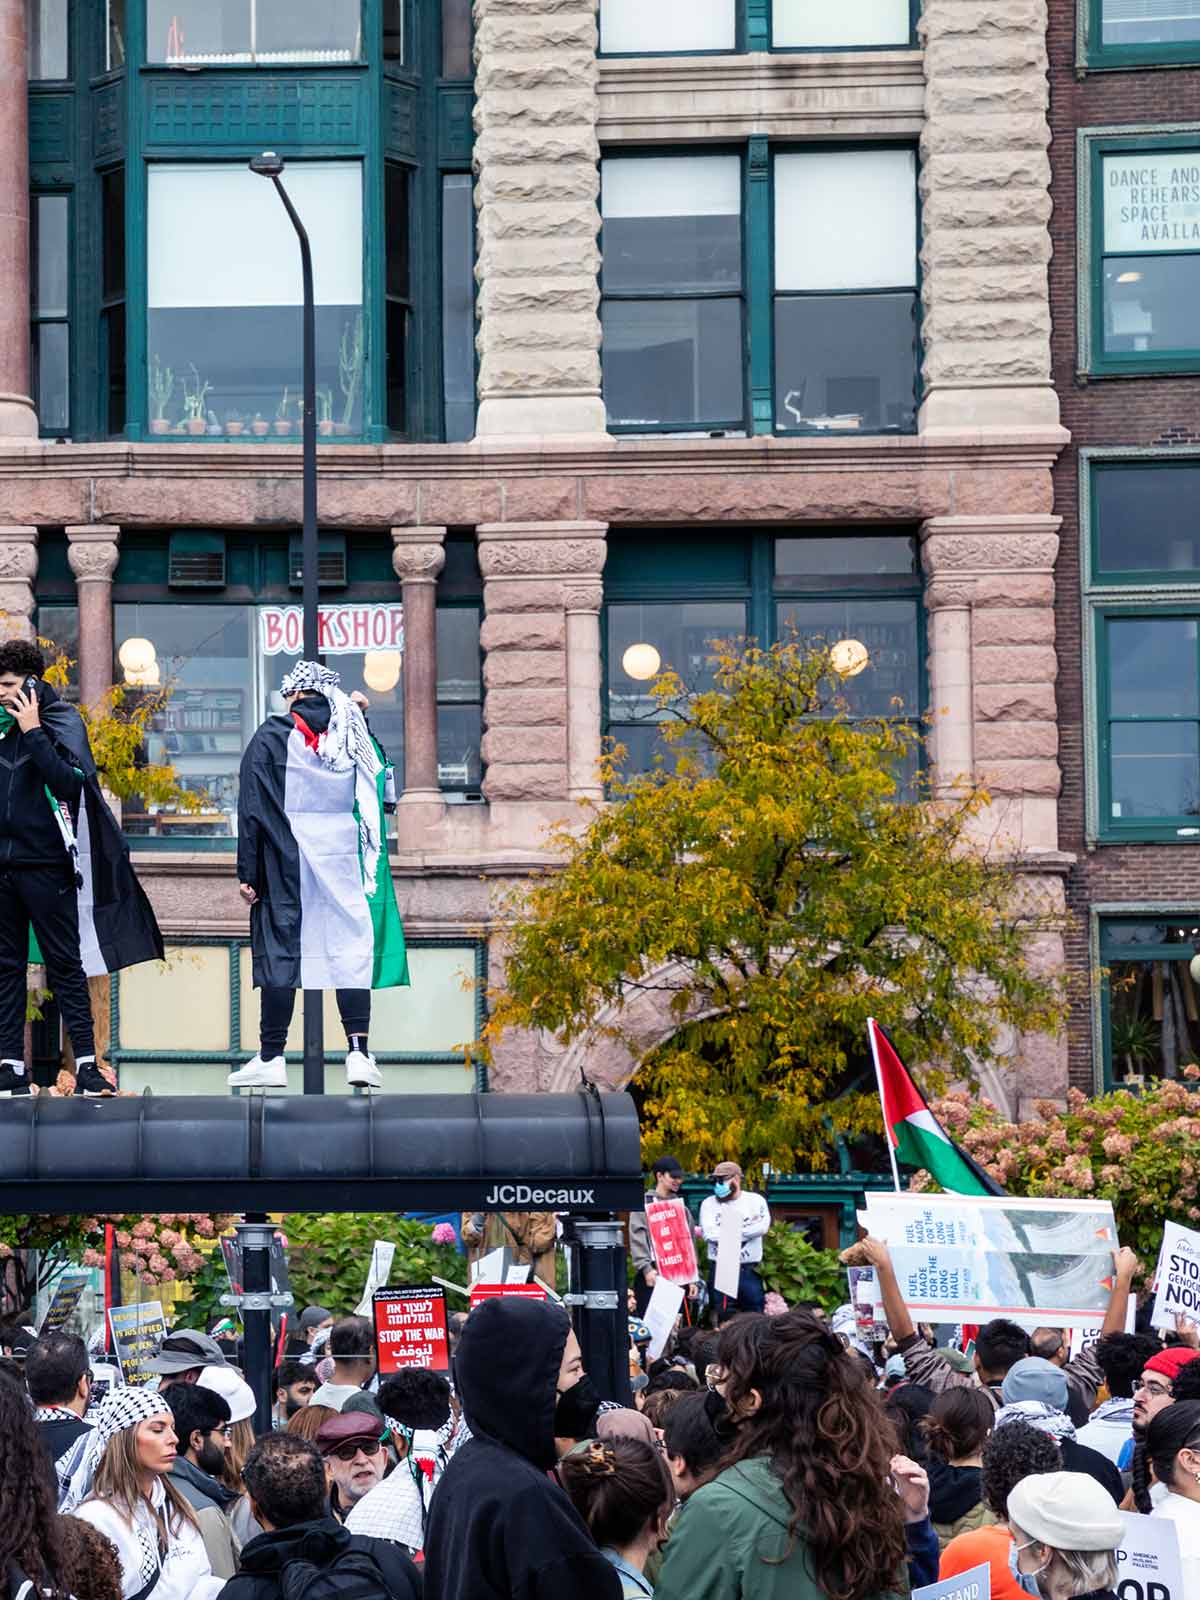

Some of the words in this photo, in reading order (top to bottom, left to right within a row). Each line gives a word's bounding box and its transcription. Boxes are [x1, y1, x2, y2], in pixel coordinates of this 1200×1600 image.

[1110, 168, 1158, 187] DANCE
[1171, 167, 1200, 184] AND
[1130, 186, 1200, 204] REHEARS
[1120, 205, 1169, 223] SPACE
[1141, 223, 1200, 240] AVAILA
[265, 609, 403, 649] BOKSHOP
[486, 1185, 594, 1204] JCDecaux
[928, 1255, 938, 1275] THE
[909, 1272, 918, 1297] FUEL
[919, 1266, 928, 1297] MADE
[930, 1277, 939, 1298] FOR
[939, 1269, 949, 1298] LONG
[386, 1303, 401, 1314] את
[388, 1311, 433, 1325] המלחמה
[379, 1330, 403, 1343] STOP
[404, 1329, 423, 1341] THE
[424, 1328, 445, 1340] WAR
[1117, 1579, 1171, 1600] OP
